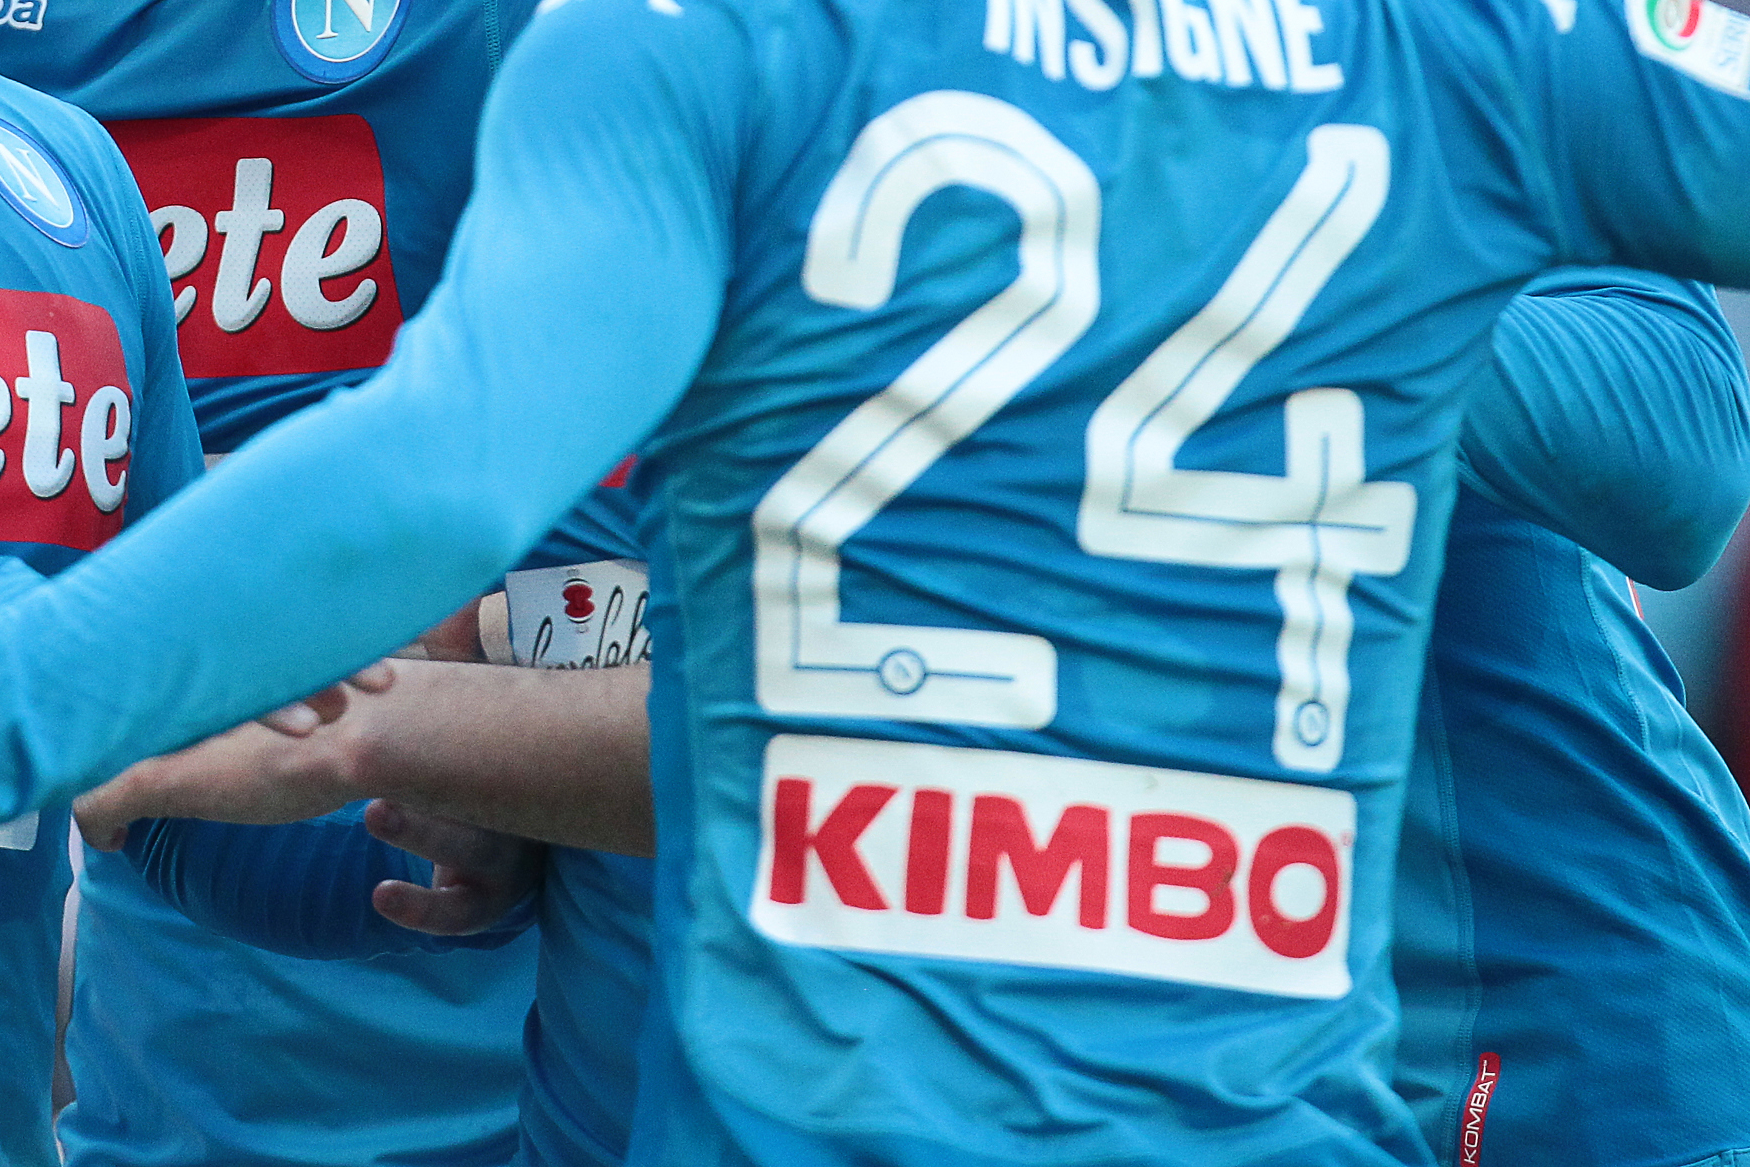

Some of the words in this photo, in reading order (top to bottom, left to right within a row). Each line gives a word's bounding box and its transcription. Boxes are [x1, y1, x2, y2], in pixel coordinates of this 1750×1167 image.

[147, 157, 383, 333] ete
[753, 89, 1418, 772] 24
[769, 776, 1340, 960] KIMBO
